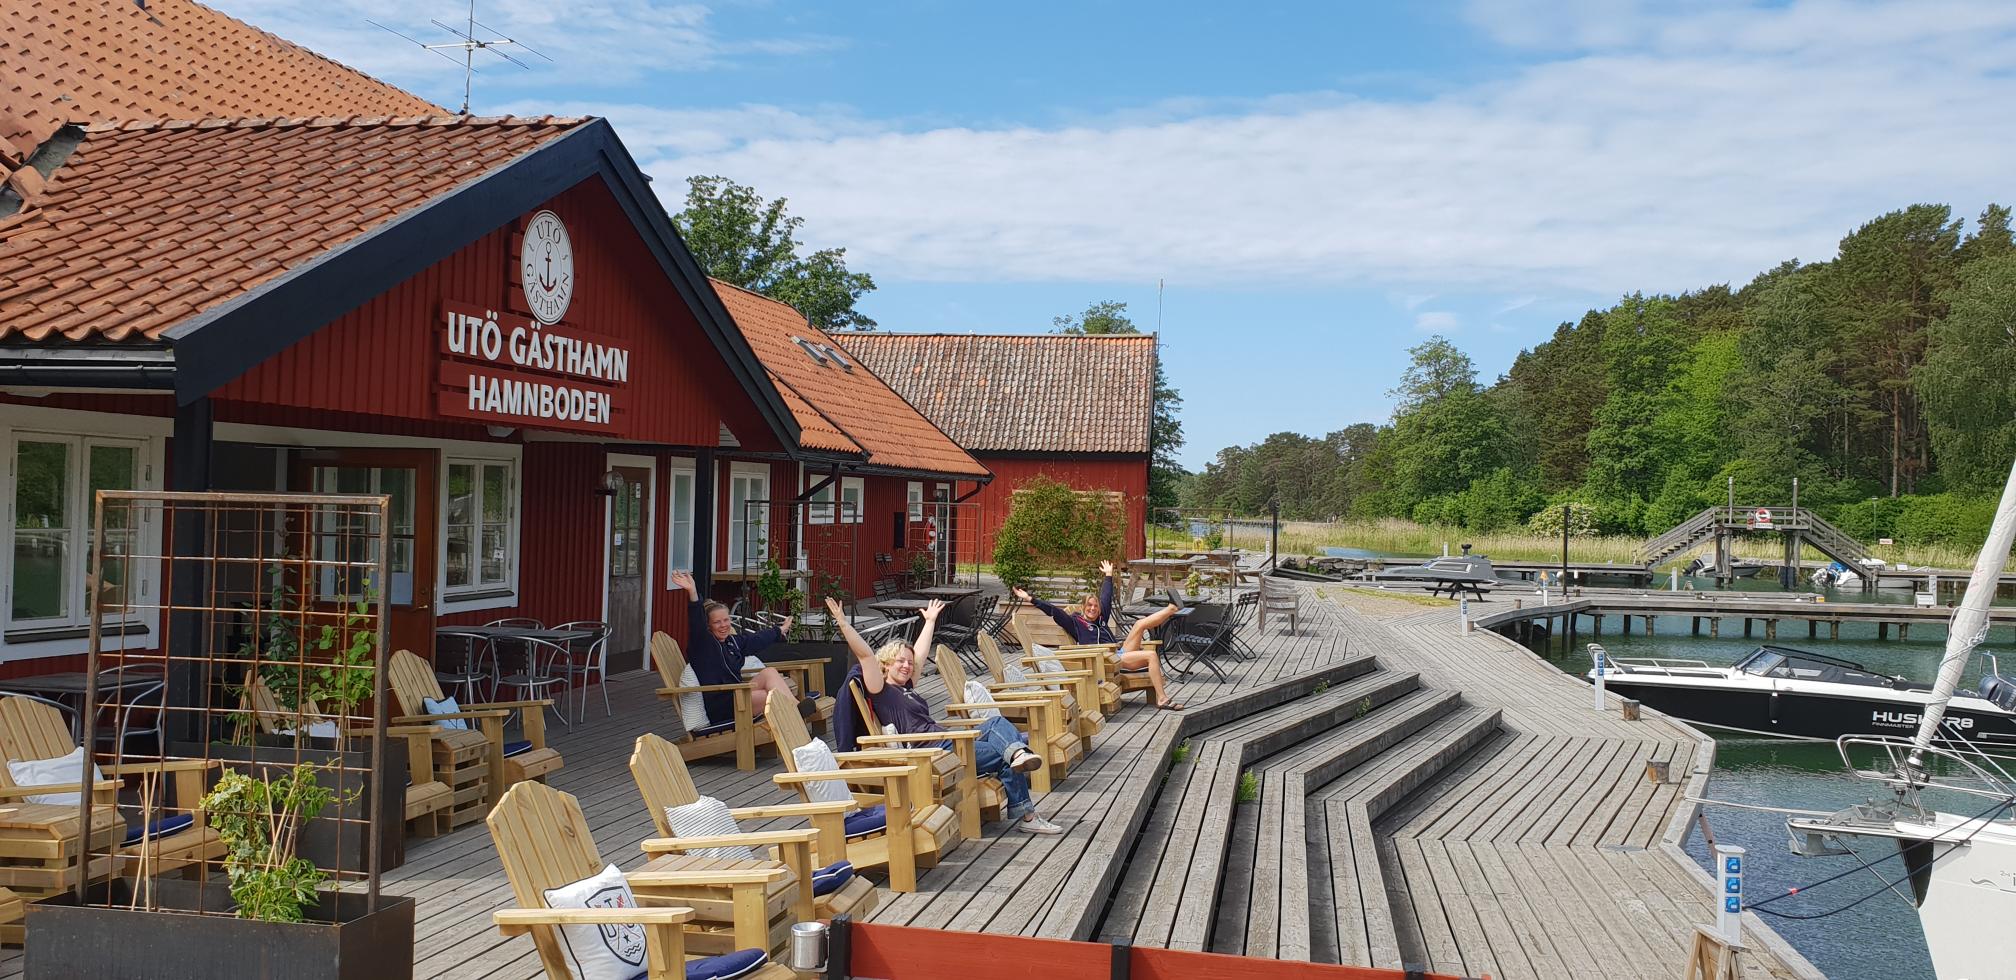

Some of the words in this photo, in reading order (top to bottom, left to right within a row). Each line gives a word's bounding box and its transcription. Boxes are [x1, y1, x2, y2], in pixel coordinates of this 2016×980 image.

[536, 220, 561, 244] UTÖ
[447, 309, 502, 361] UTÖ
[509, 320, 629, 383] GÄSTHAMN
[468, 374, 611, 424] HAMNBODEN
